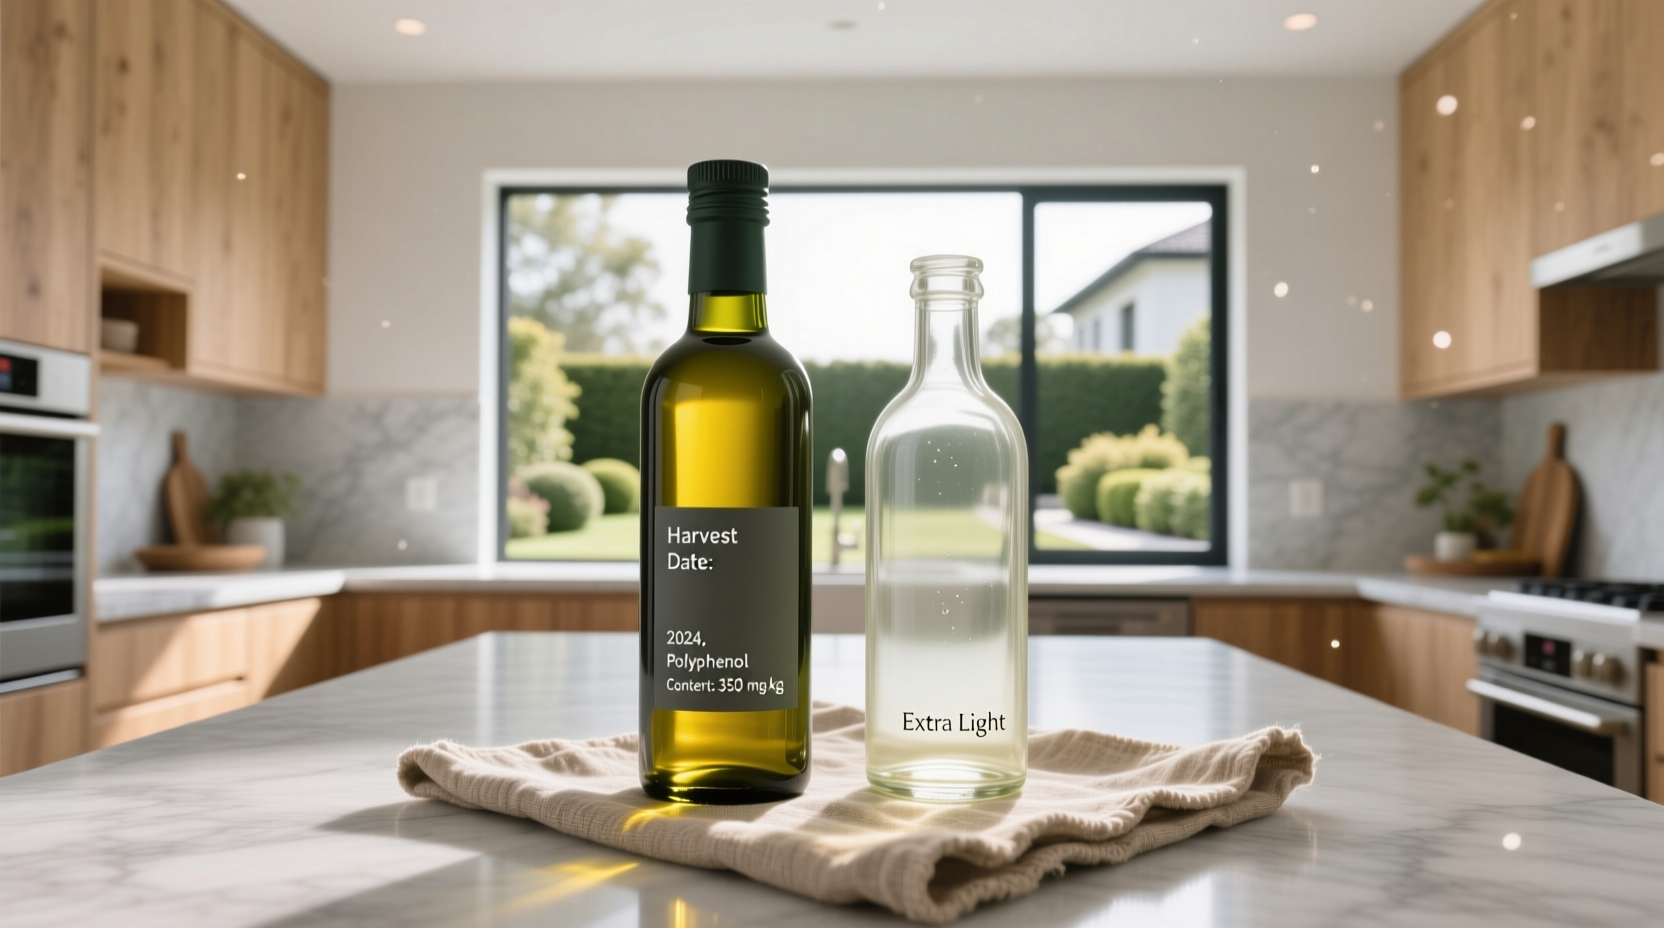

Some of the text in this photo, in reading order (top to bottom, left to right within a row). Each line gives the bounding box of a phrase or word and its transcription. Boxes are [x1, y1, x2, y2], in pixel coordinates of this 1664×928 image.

[667, 526, 738, 544] Harvest
[667, 552, 713, 571] Date:
[666, 630, 706, 647] 2024,
[666, 653, 749, 672] Polyphenol
[717, 677, 743, 692] 350
[903, 711, 1006, 738] Extra Light
